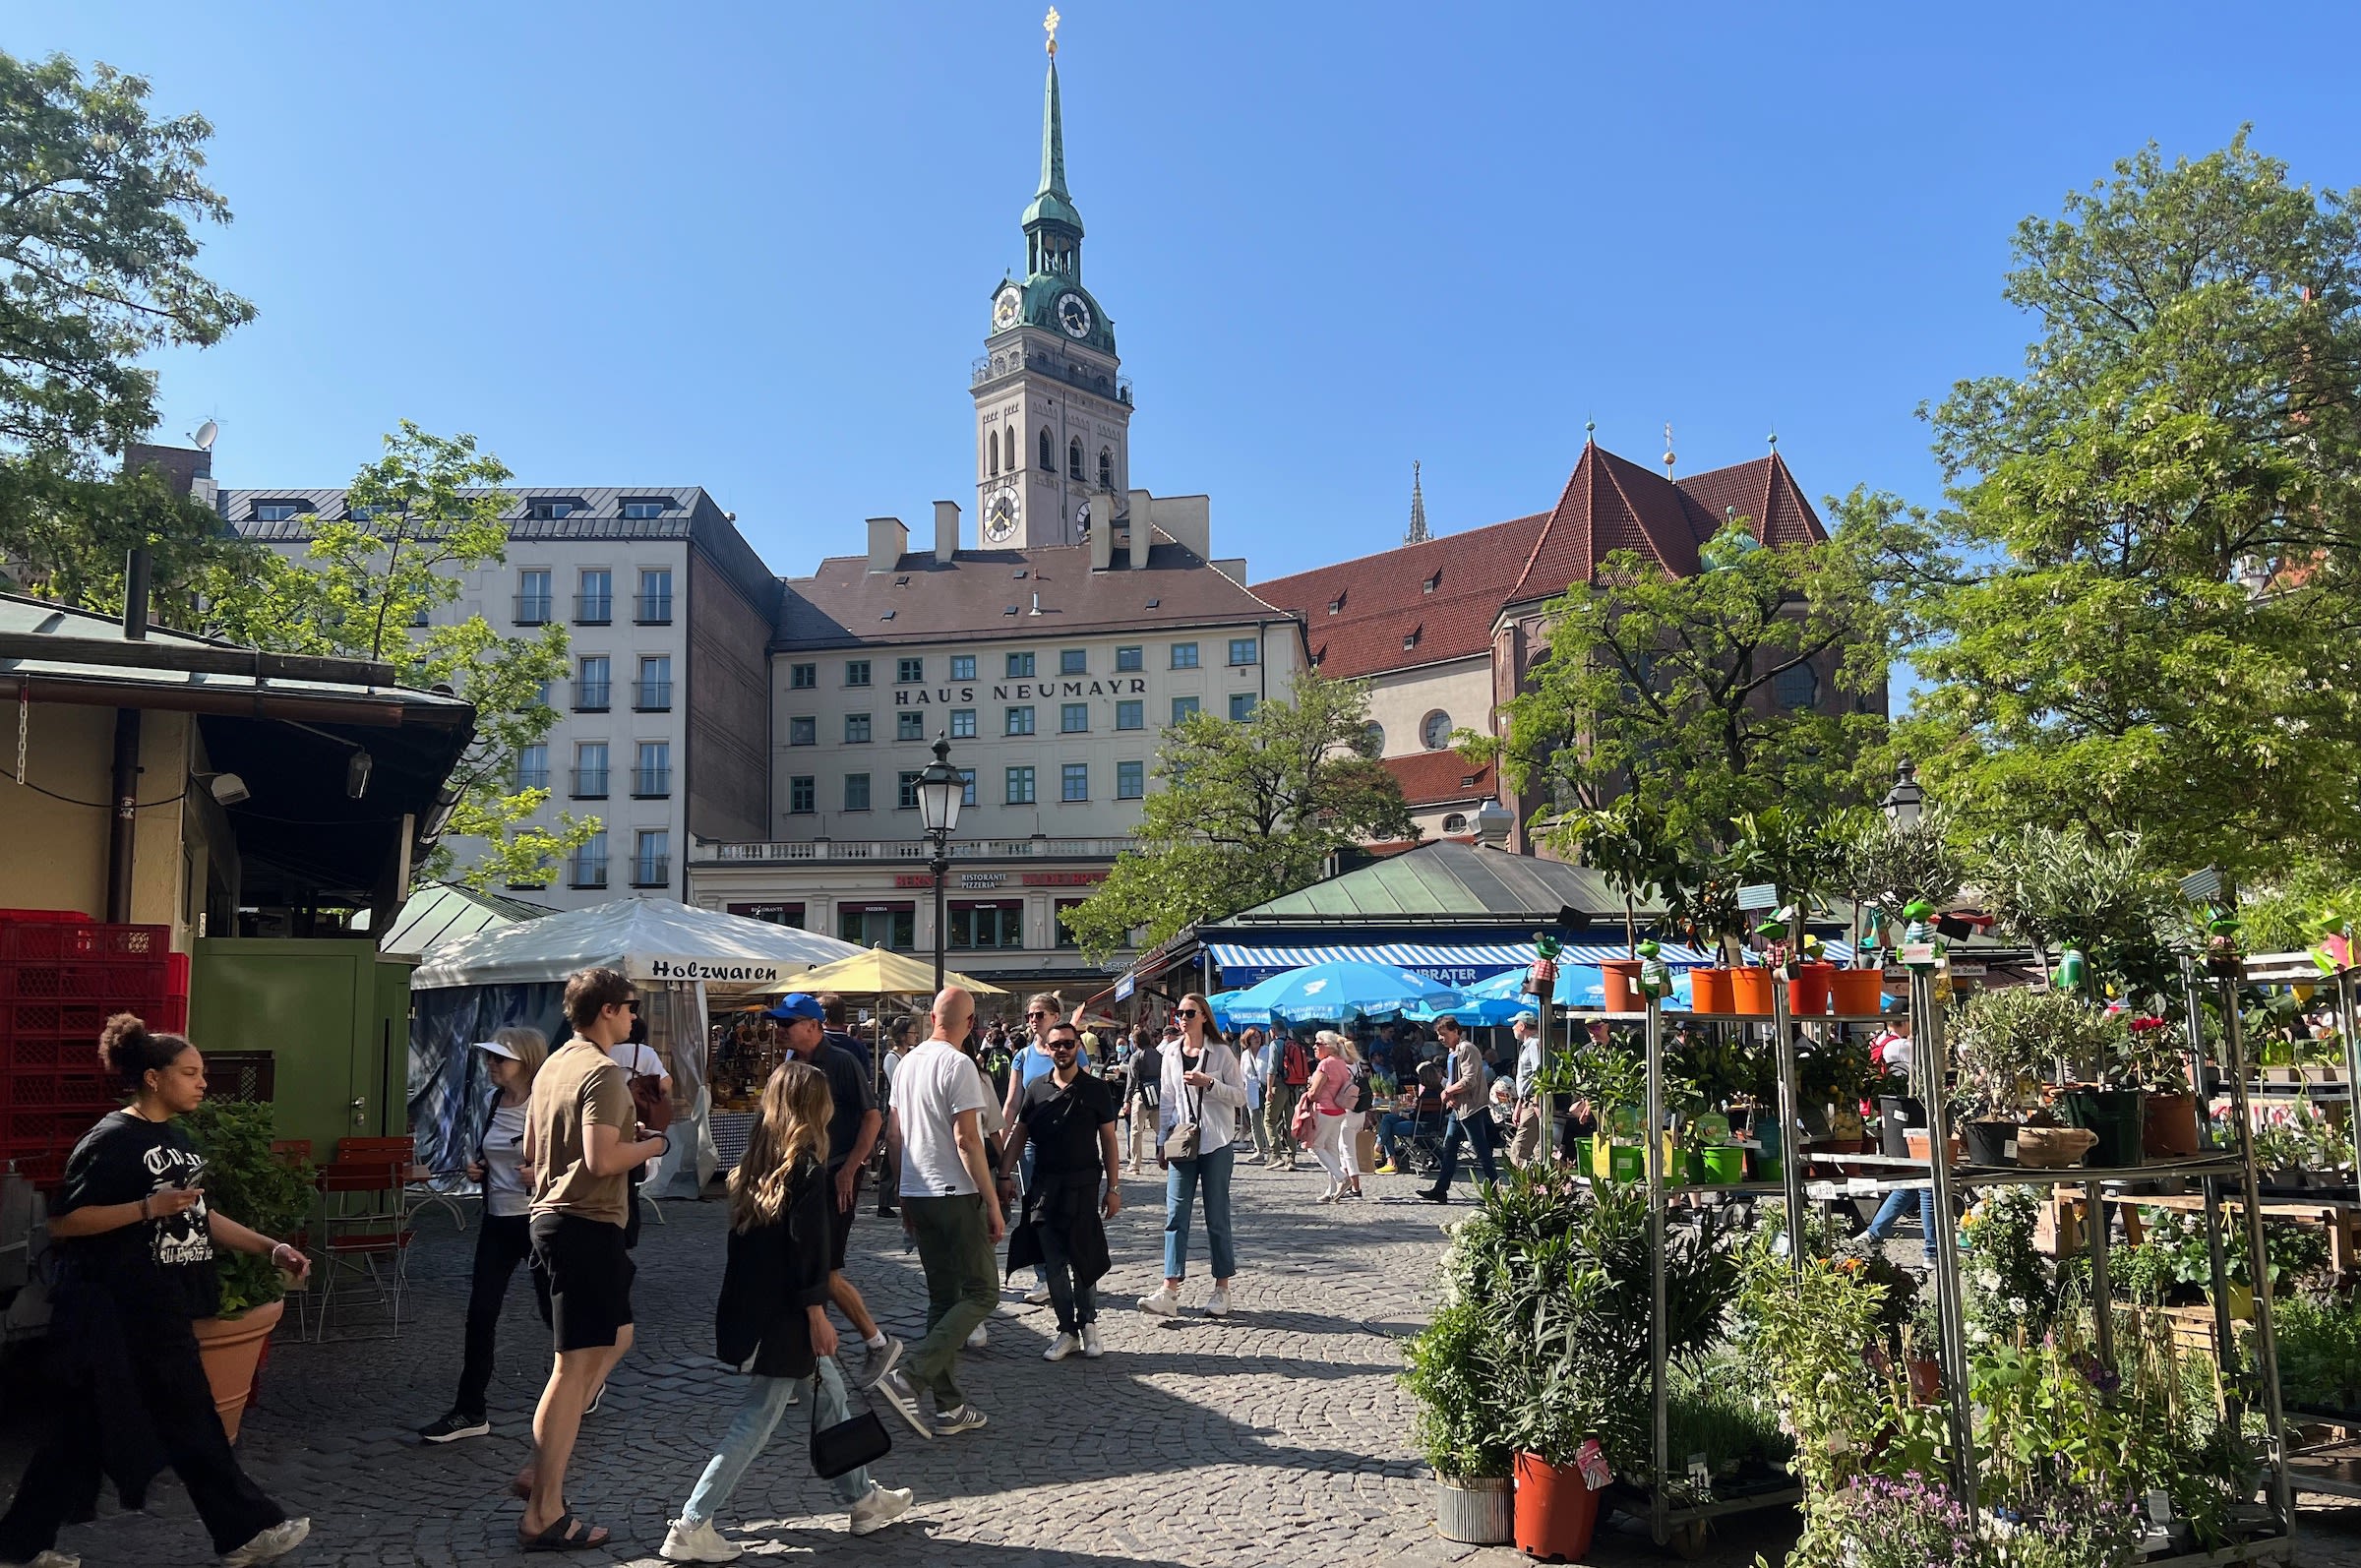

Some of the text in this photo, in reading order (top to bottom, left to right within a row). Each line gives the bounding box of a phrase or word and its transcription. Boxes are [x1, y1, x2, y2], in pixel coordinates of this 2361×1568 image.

[895, 679, 1146, 705] HAUS NEUMAYR
[652, 960, 777, 980] Holzwaren
